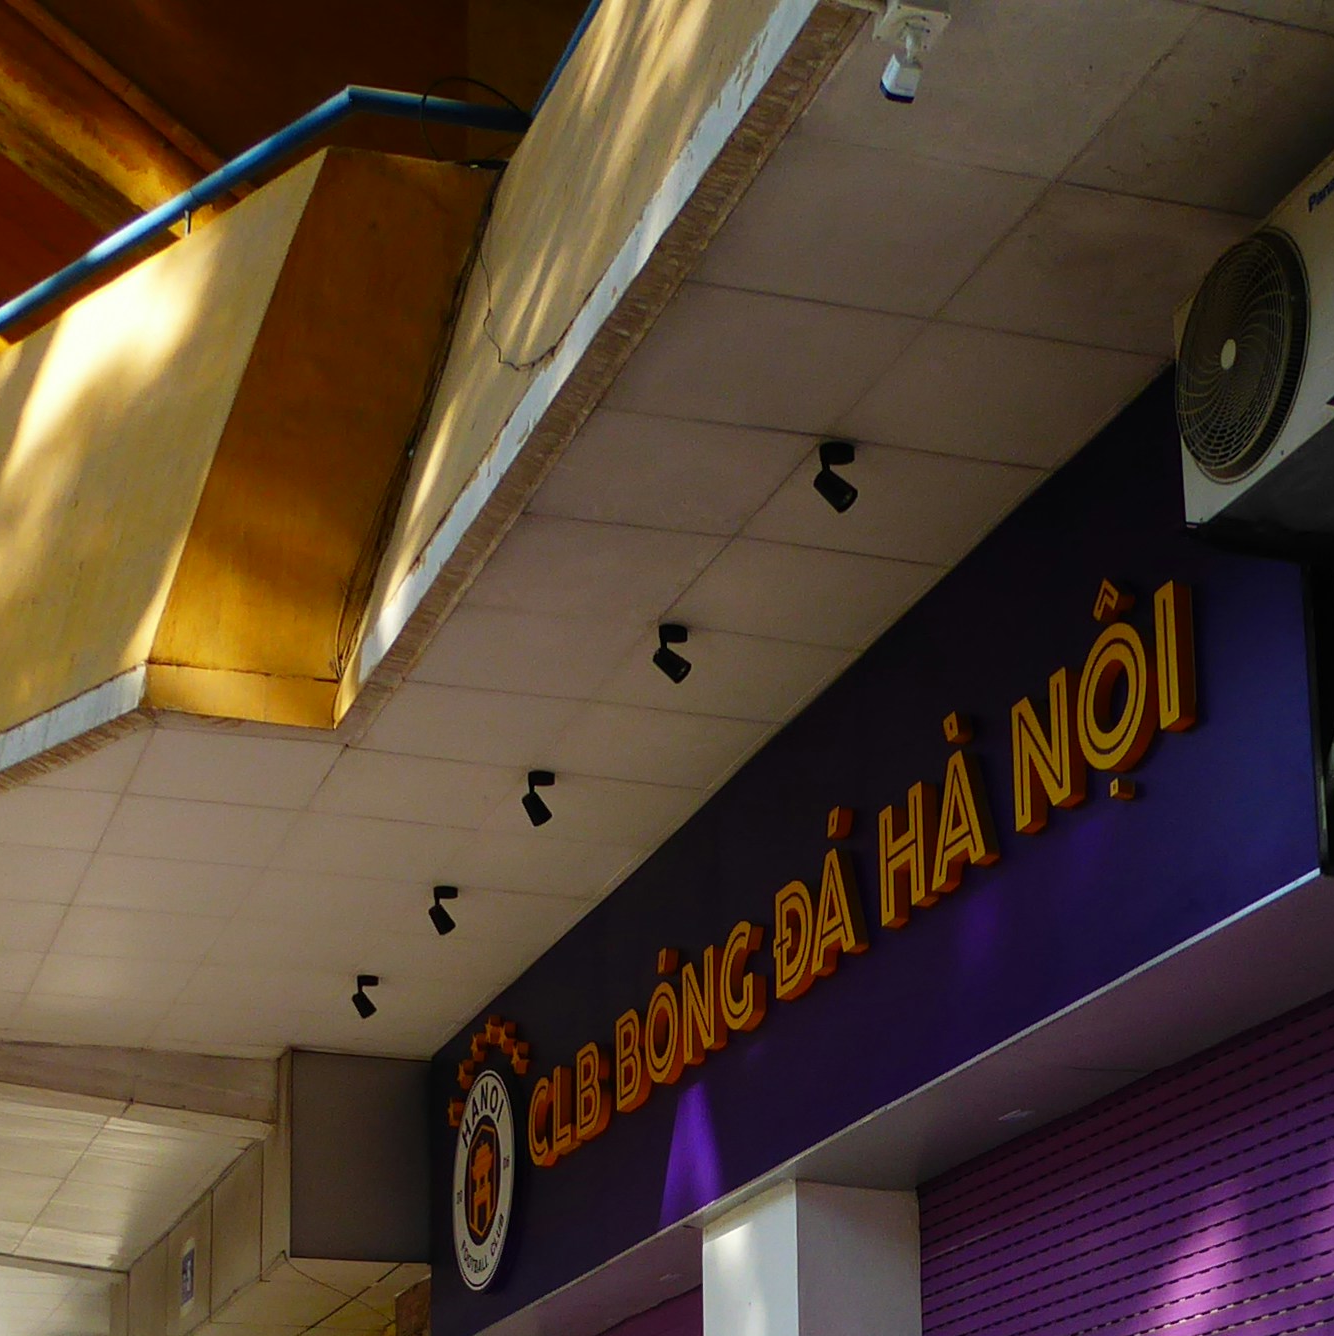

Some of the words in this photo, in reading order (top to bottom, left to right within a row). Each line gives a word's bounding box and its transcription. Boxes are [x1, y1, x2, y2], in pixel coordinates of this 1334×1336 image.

[528, 1041, 610, 1168] CLB
[615, 920, 767, 1113] BÓNG
[773, 804, 869, 1001] ĐÁ
[878, 710, 1000, 929] HÀ
[1011, 578, 1197, 834] NỘI
[462, 1082, 505, 1147] HANOI
[461, 1239, 489, 1274] FOOTBALL
[489, 1213, 505, 1257] CLUB
